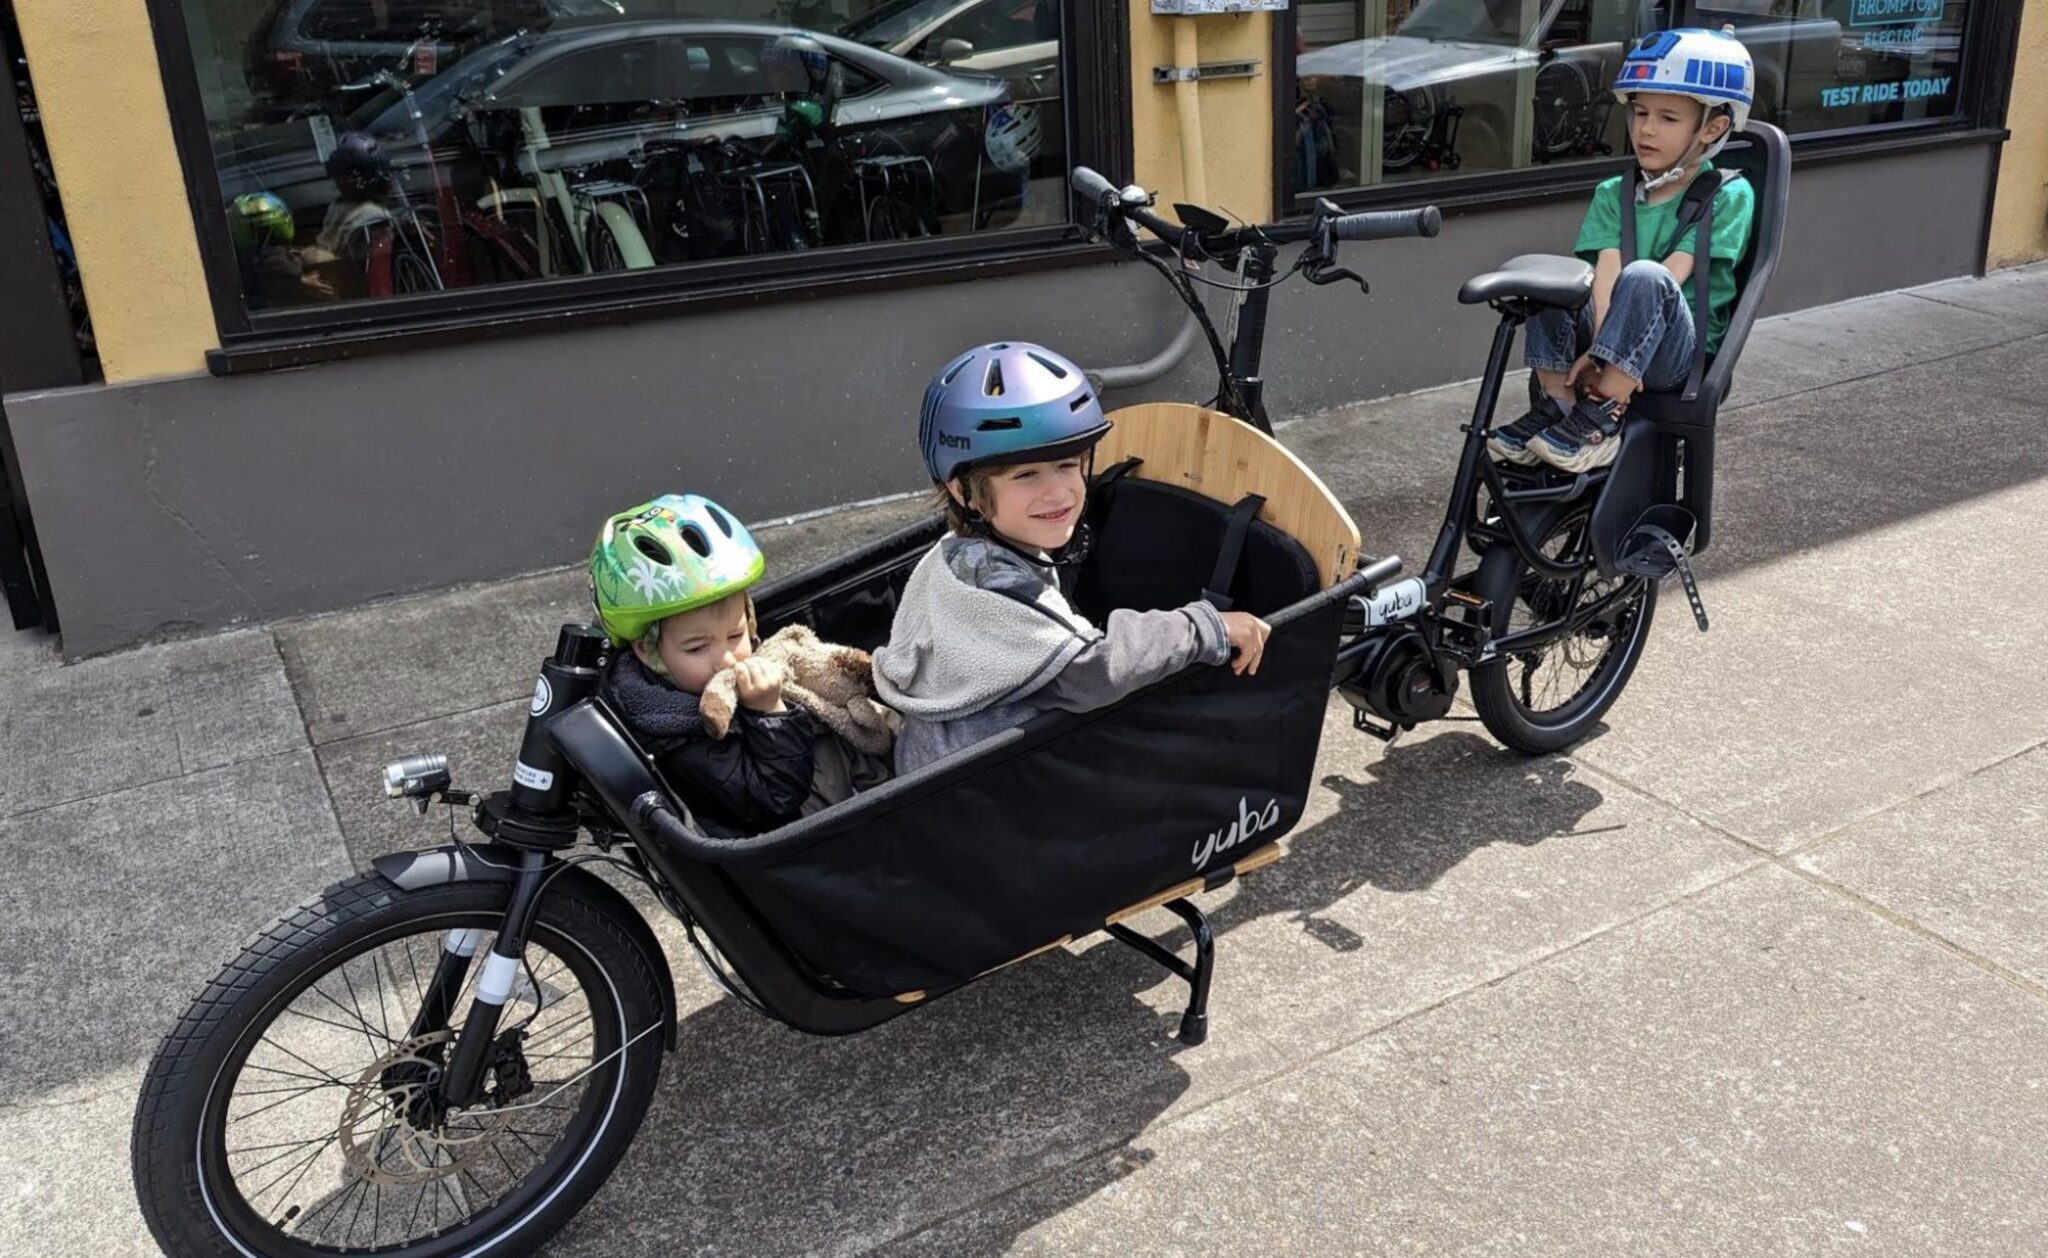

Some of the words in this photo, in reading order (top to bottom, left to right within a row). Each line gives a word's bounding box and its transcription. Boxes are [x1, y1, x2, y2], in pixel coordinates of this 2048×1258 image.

[1857, 0, 1938, 16] BROMPTON
[1863, 28, 1926, 47] ELECTRIC
[1821, 87, 1859, 107] TEST
[1862, 82, 1898, 103] RIDE
[1902, 77, 1951, 98] TODAY
[939, 430, 971, 450] bern
[1379, 591, 1412, 622] yuba
[1191, 796, 1280, 872] yuba
